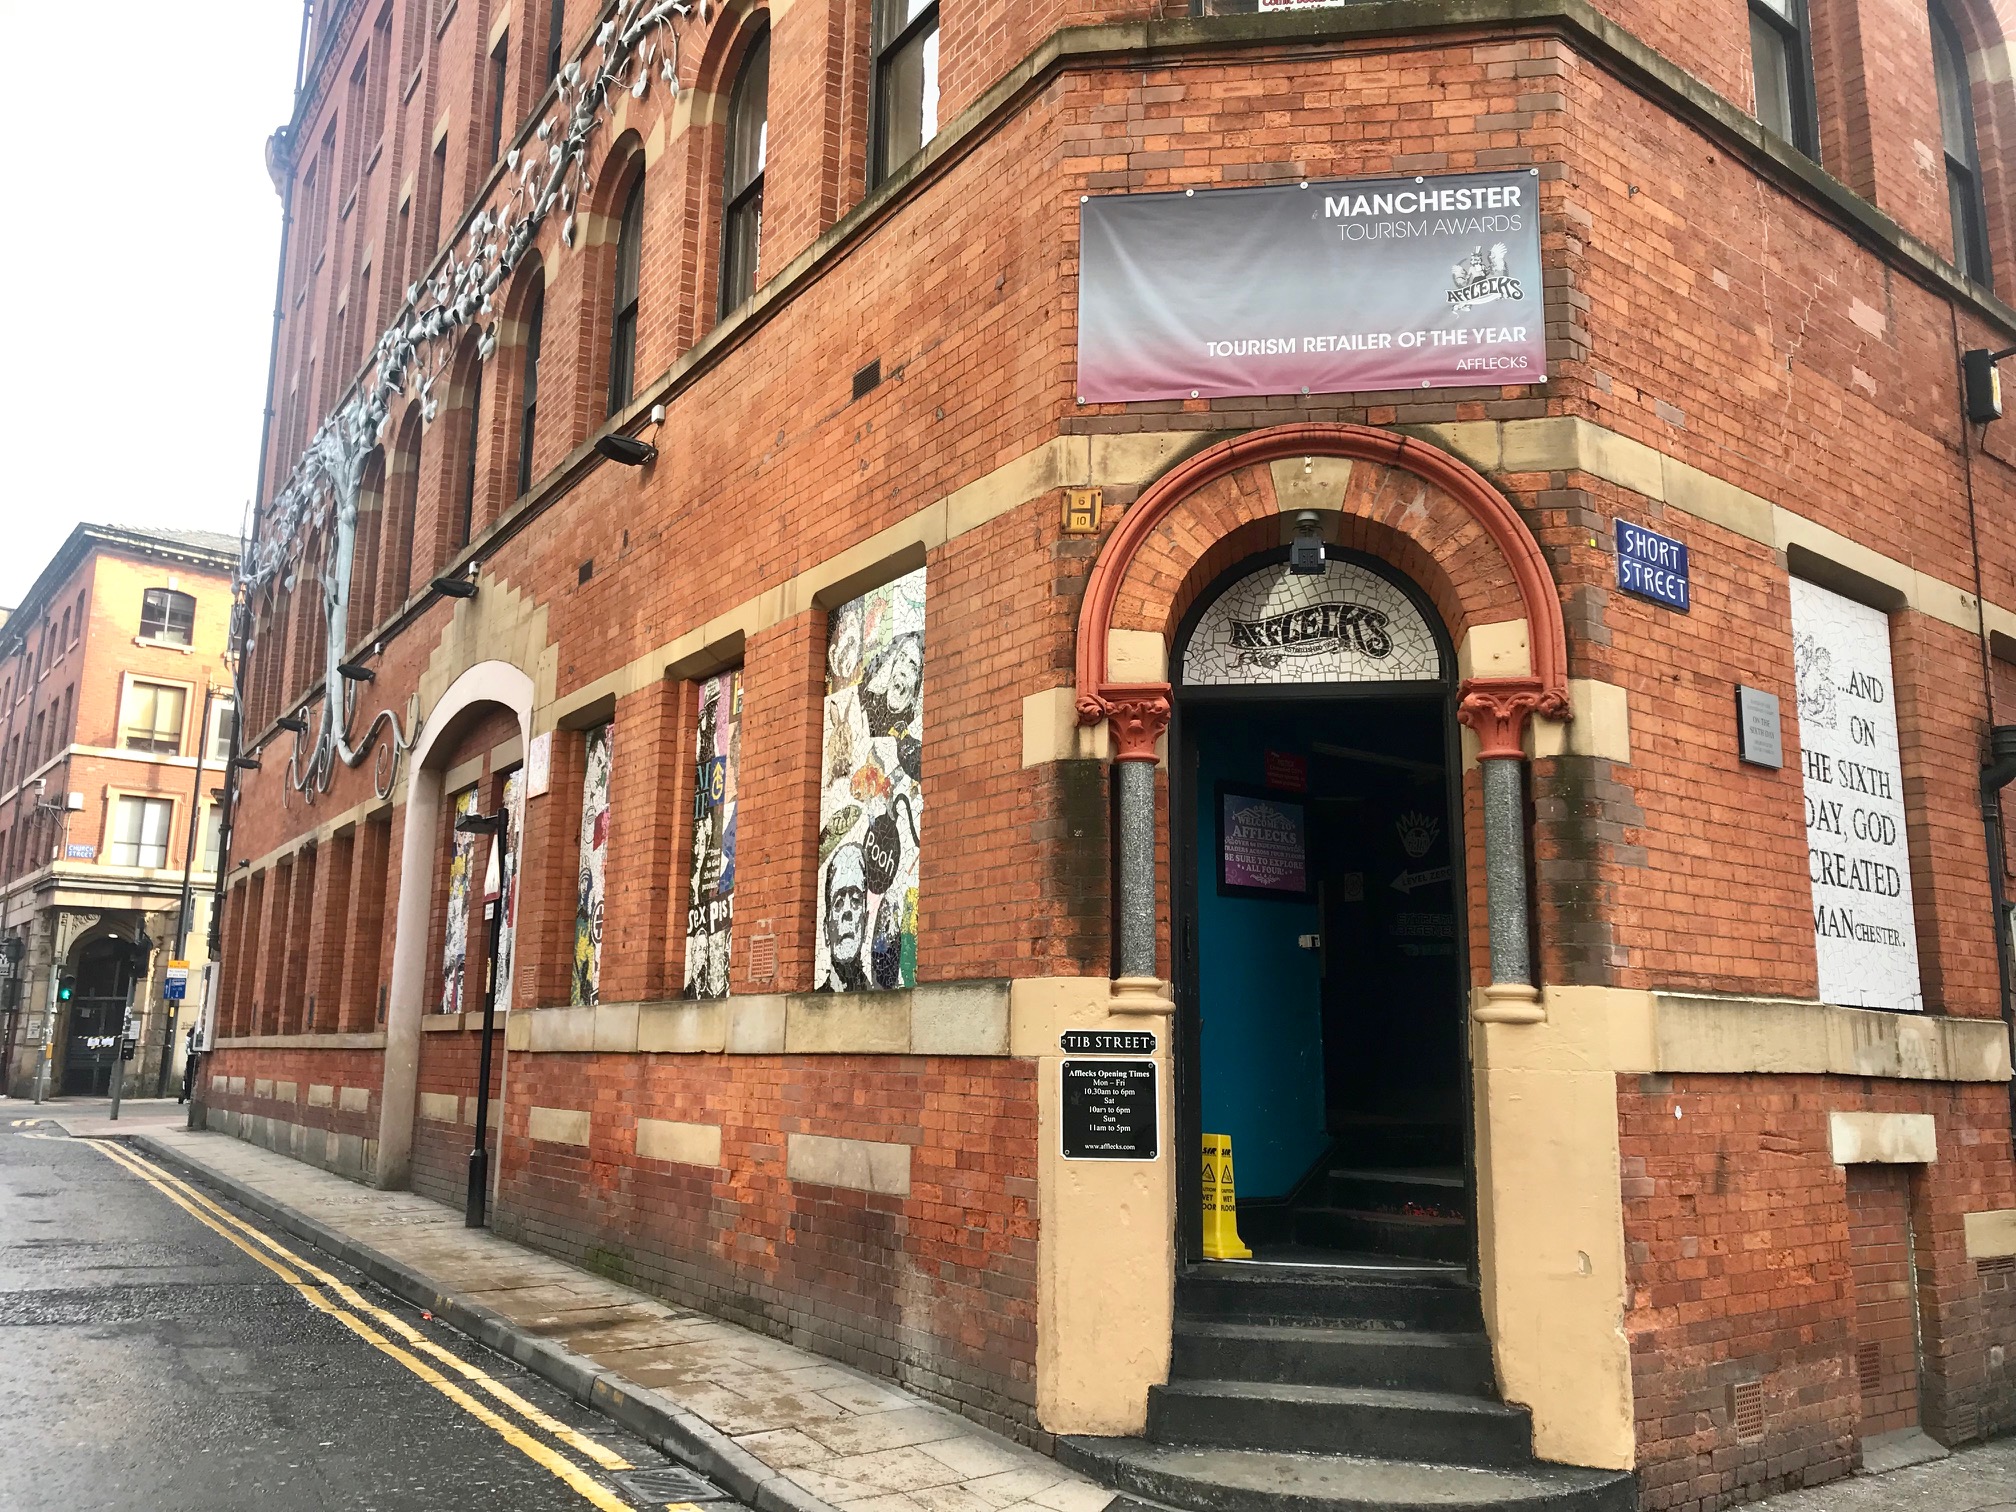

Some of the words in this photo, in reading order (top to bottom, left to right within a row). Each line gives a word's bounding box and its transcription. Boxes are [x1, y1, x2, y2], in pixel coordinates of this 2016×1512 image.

[1324, 186, 1521, 218] MANCHESTER
[1337, 219, 1427, 241] TOURISM
[1432, 214, 1522, 236] AWARDS
[1446, 277, 1524, 303] AFFLECKS
[1207, 338, 1296, 357] TOURISM
[1303, 333, 1391, 353] RETAILER
[1398, 331, 1426, 348] OF
[1431, 329, 1468, 346] THE
[1472, 326, 1527, 344] YEAR
[1456, 356, 1528, 371] AFFLECKS
[1066, 494, 1096, 528] H
[1078, 497, 1085, 505] 6
[1076, 516, 1087, 526] 10
[1625, 530, 1679, 570] SHORT
[1622, 560, 1686, 602] STREET
[1837, 670, 1884, 704] ...AND
[1850, 715, 1876, 748] ON
[1838, 759, 1893, 800] SIXTH
[1237, 816, 1278, 829] WELCOME
[1281, 821, 1292, 831] TO
[1804, 795, 1848, 843] DAY,
[1853, 808, 1896, 846] GOD
[1232, 825, 1297, 844] AFFLECKS
[68, 850, 93, 858] STREET
[865, 831, 895, 876] Pooh
[1225, 853, 1234, 861] BE
[1235, 854, 1257, 864] SURE
[1257, 857, 1267, 865] TO
[1270, 859, 1304, 869] EXPLORE
[1246, 864, 1260, 872] ALL
[1808, 848, 1901, 898] CREATED
[1067, 1036, 1090, 1048] TIB
[1095, 1036, 1150, 1048] STREET
[1098, 1070, 1127, 1078] Opening
[1129, 1070, 1150, 1078] Times
[1120, 1088, 1136, 1097] 6pm
[1116, 1106, 1131, 1115] 6pm
[1116, 1124, 1131, 1133] 5pm
